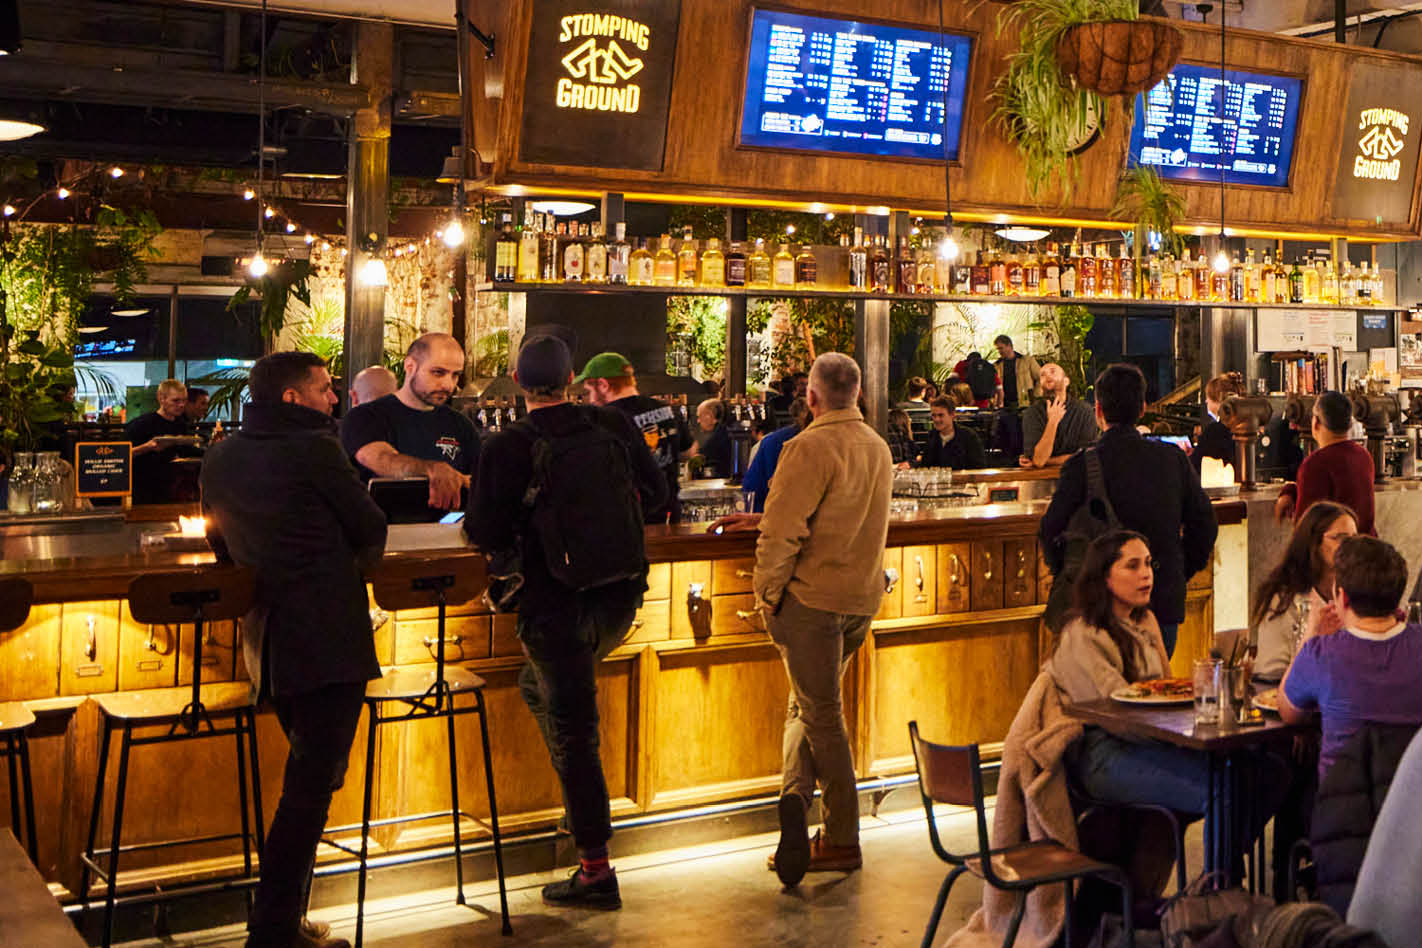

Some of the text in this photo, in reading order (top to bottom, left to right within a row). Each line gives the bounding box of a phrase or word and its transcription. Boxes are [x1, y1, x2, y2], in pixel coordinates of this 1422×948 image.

[559, 13, 650, 51] STOMPING
[556, 78, 640, 113] GROUND
[1359, 108, 1409, 135] STOMPING
[1353, 155, 1400, 181] GROUND
